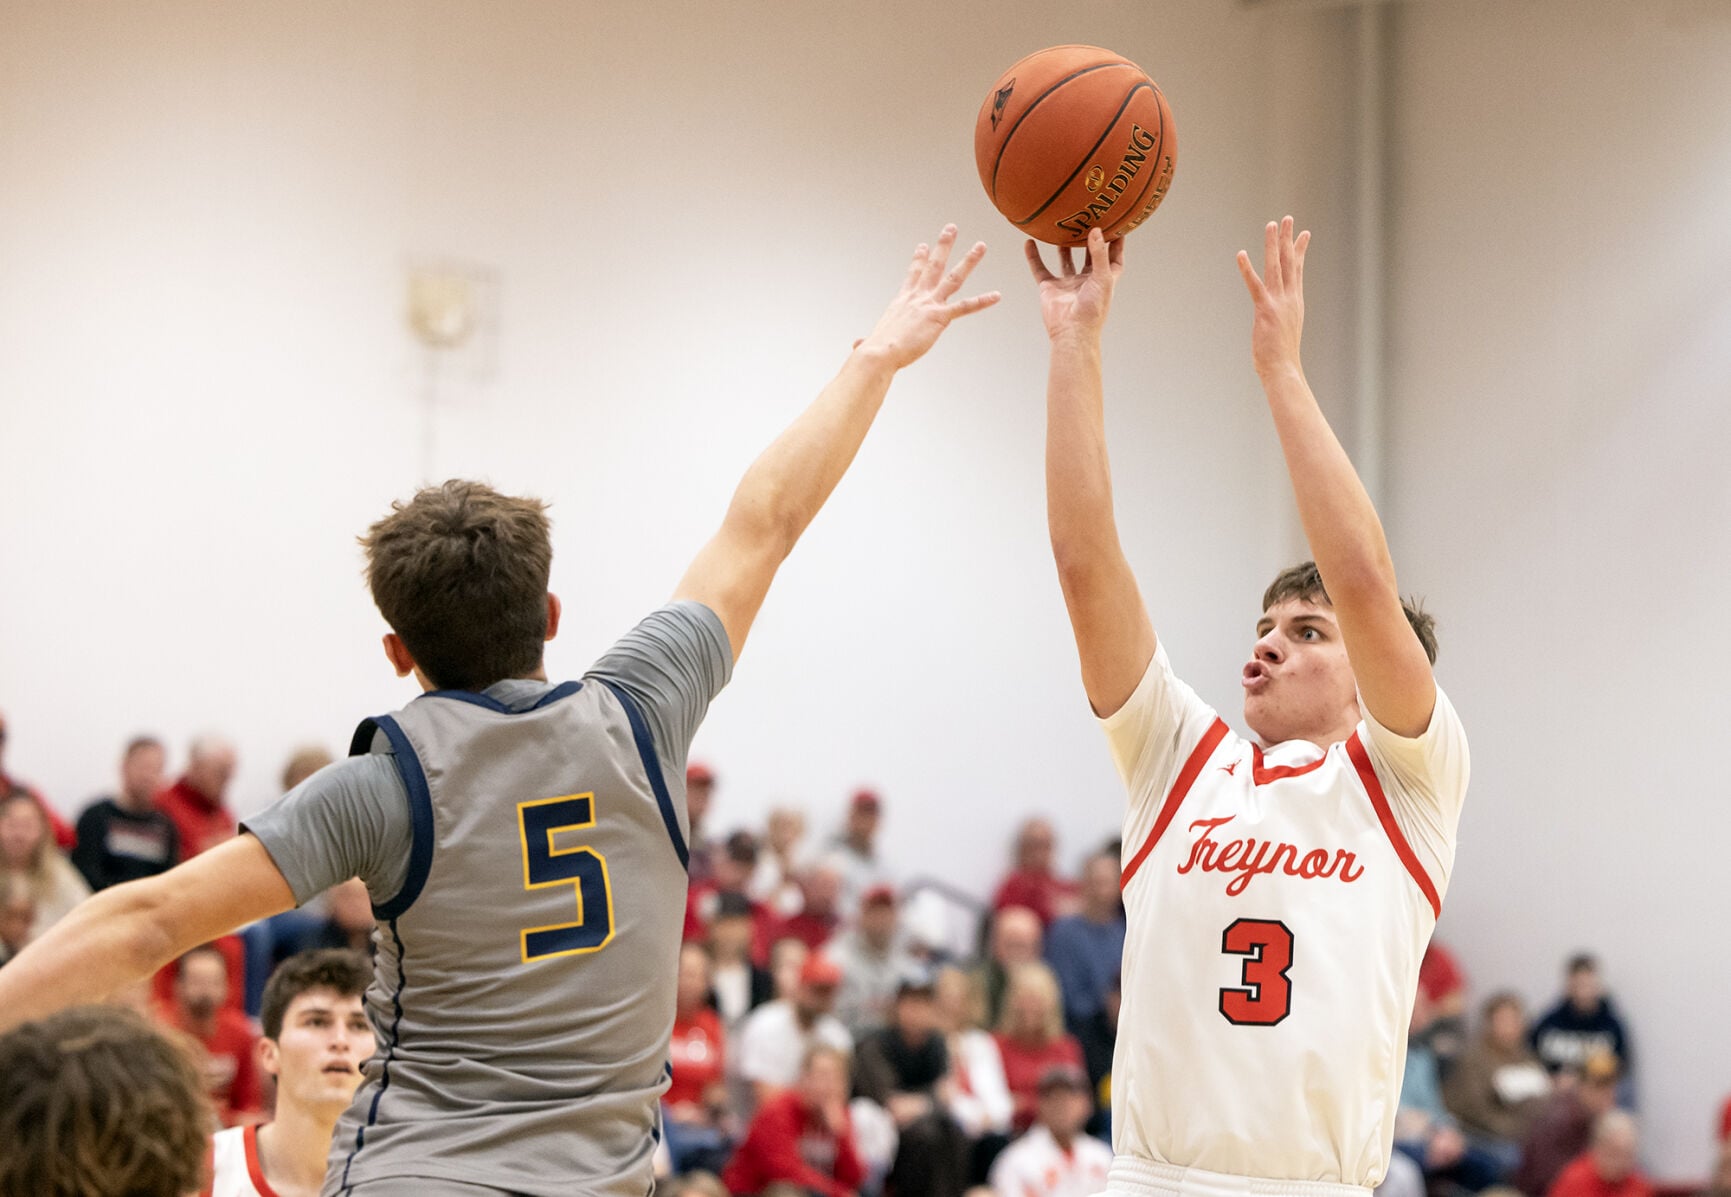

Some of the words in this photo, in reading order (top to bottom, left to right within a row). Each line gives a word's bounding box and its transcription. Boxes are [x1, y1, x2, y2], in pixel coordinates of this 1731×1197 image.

[1056, 123, 1157, 237] SPALDING
[516, 791, 616, 964] 5
[1177, 814, 1365, 897] Treynor
[1218, 917, 1295, 1027] 3
